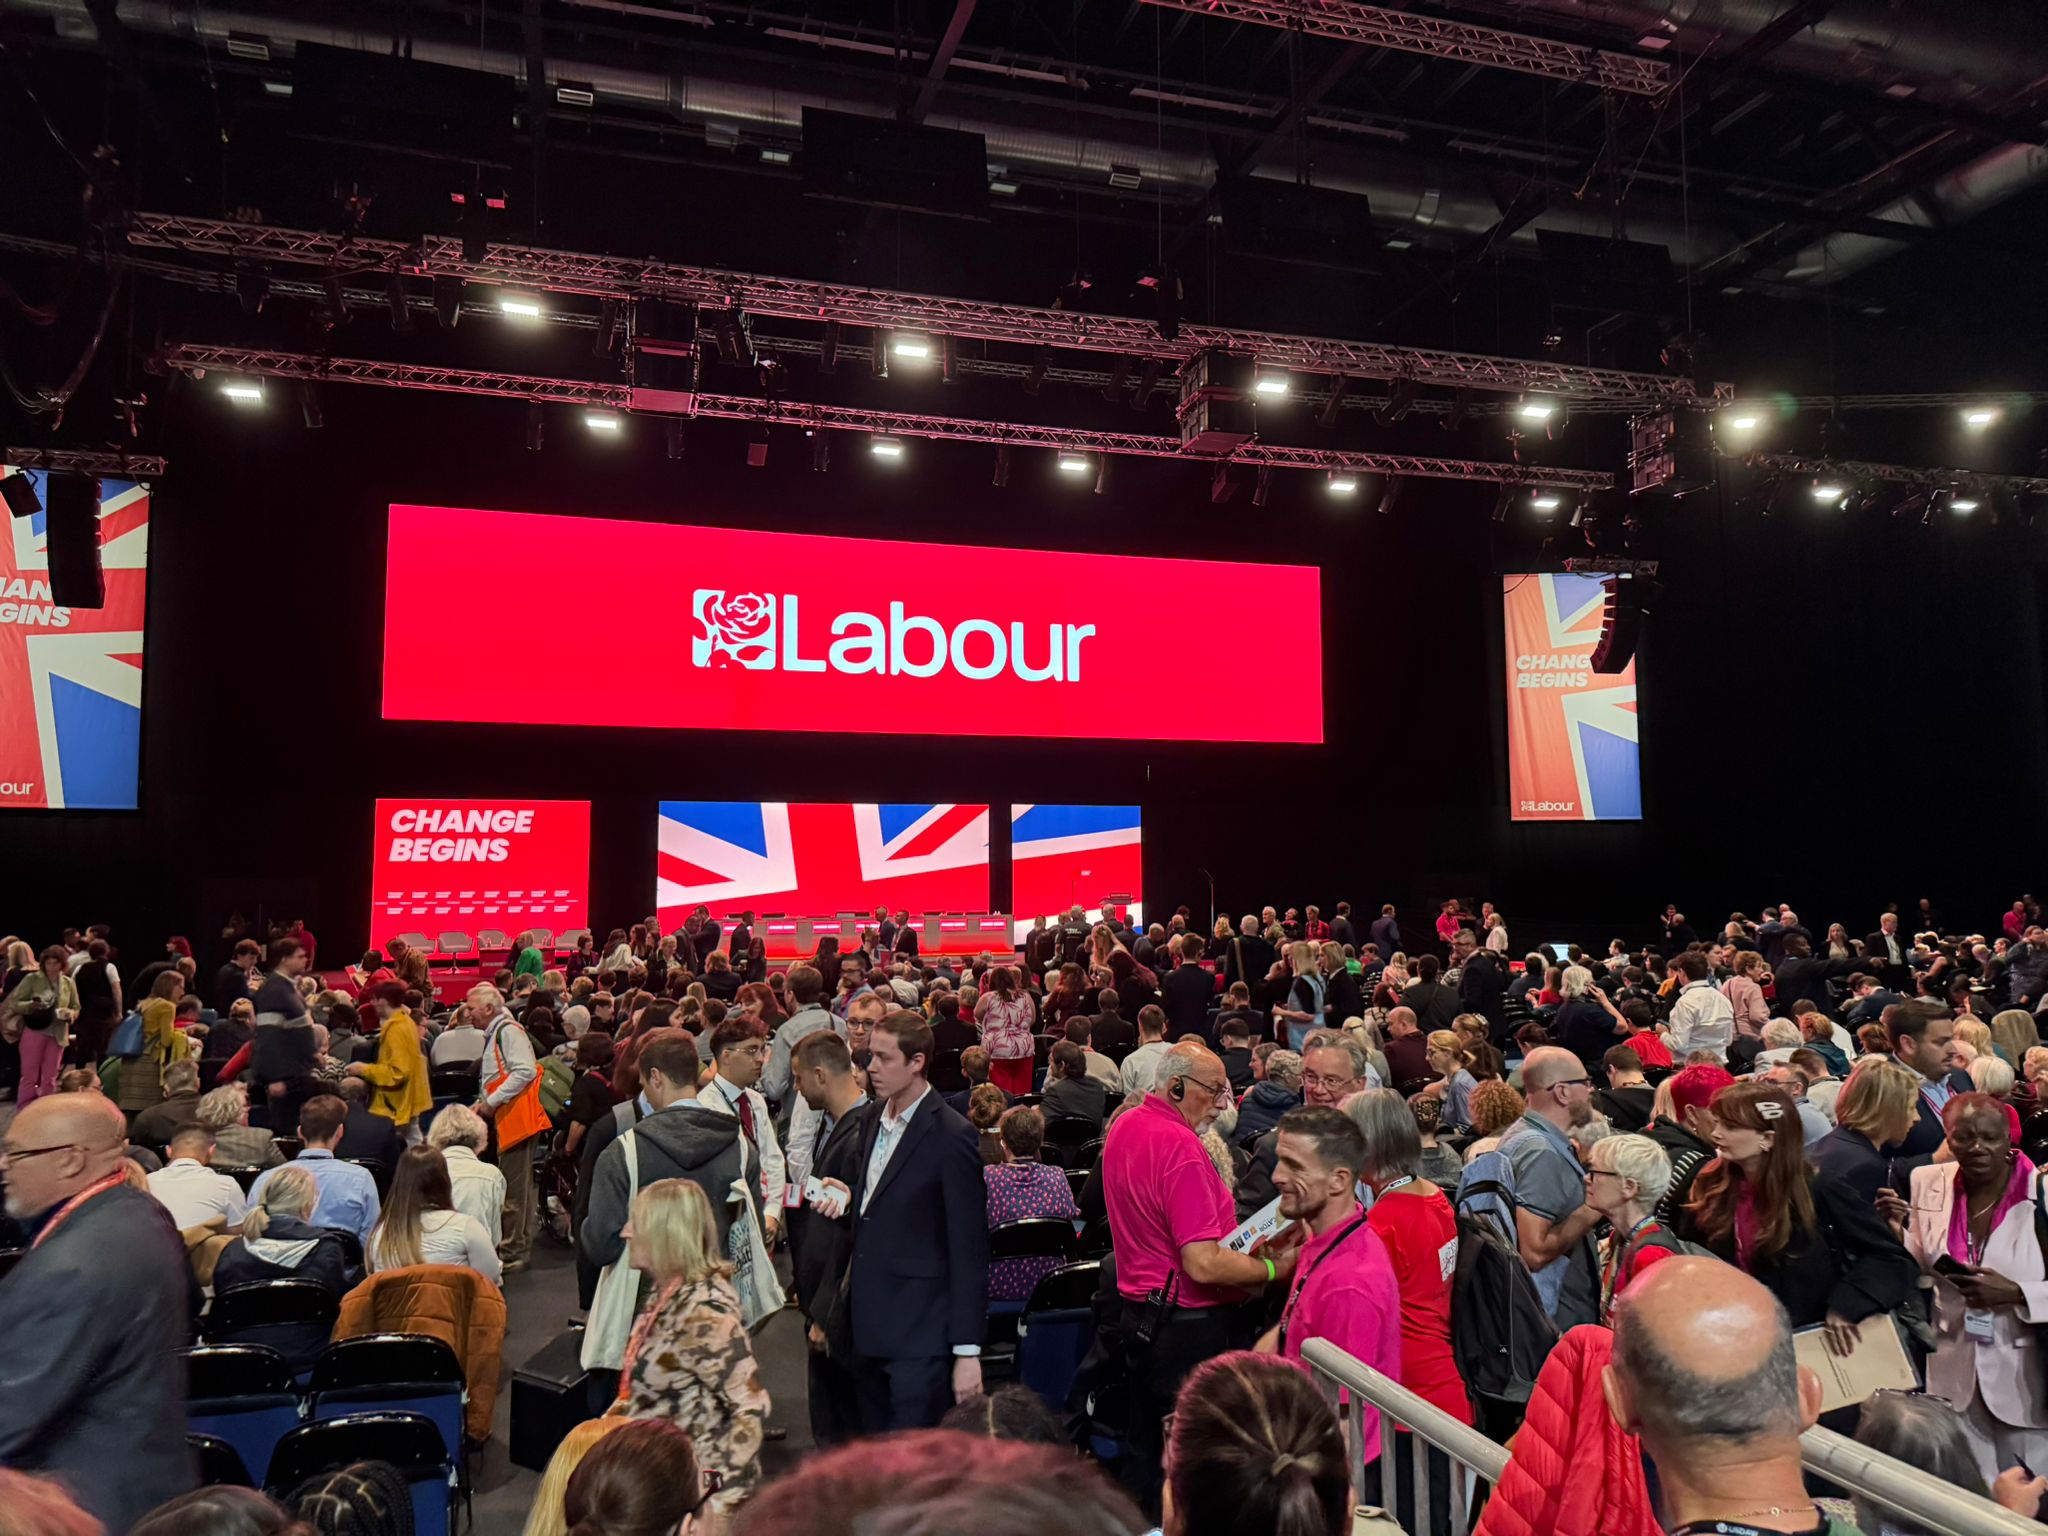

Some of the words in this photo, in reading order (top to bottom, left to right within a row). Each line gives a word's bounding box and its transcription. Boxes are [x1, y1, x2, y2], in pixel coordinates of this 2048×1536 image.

[0, 577, 52, 601] AN
[783, 594, 1096, 682] Labour
[1516, 654, 1591, 670] CHANG
[1517, 672, 1588, 687] BEGINS
[1532, 801, 1574, 812] Labour
[390, 809, 535, 833] CHANGE
[388, 838, 510, 862] BEGINS
